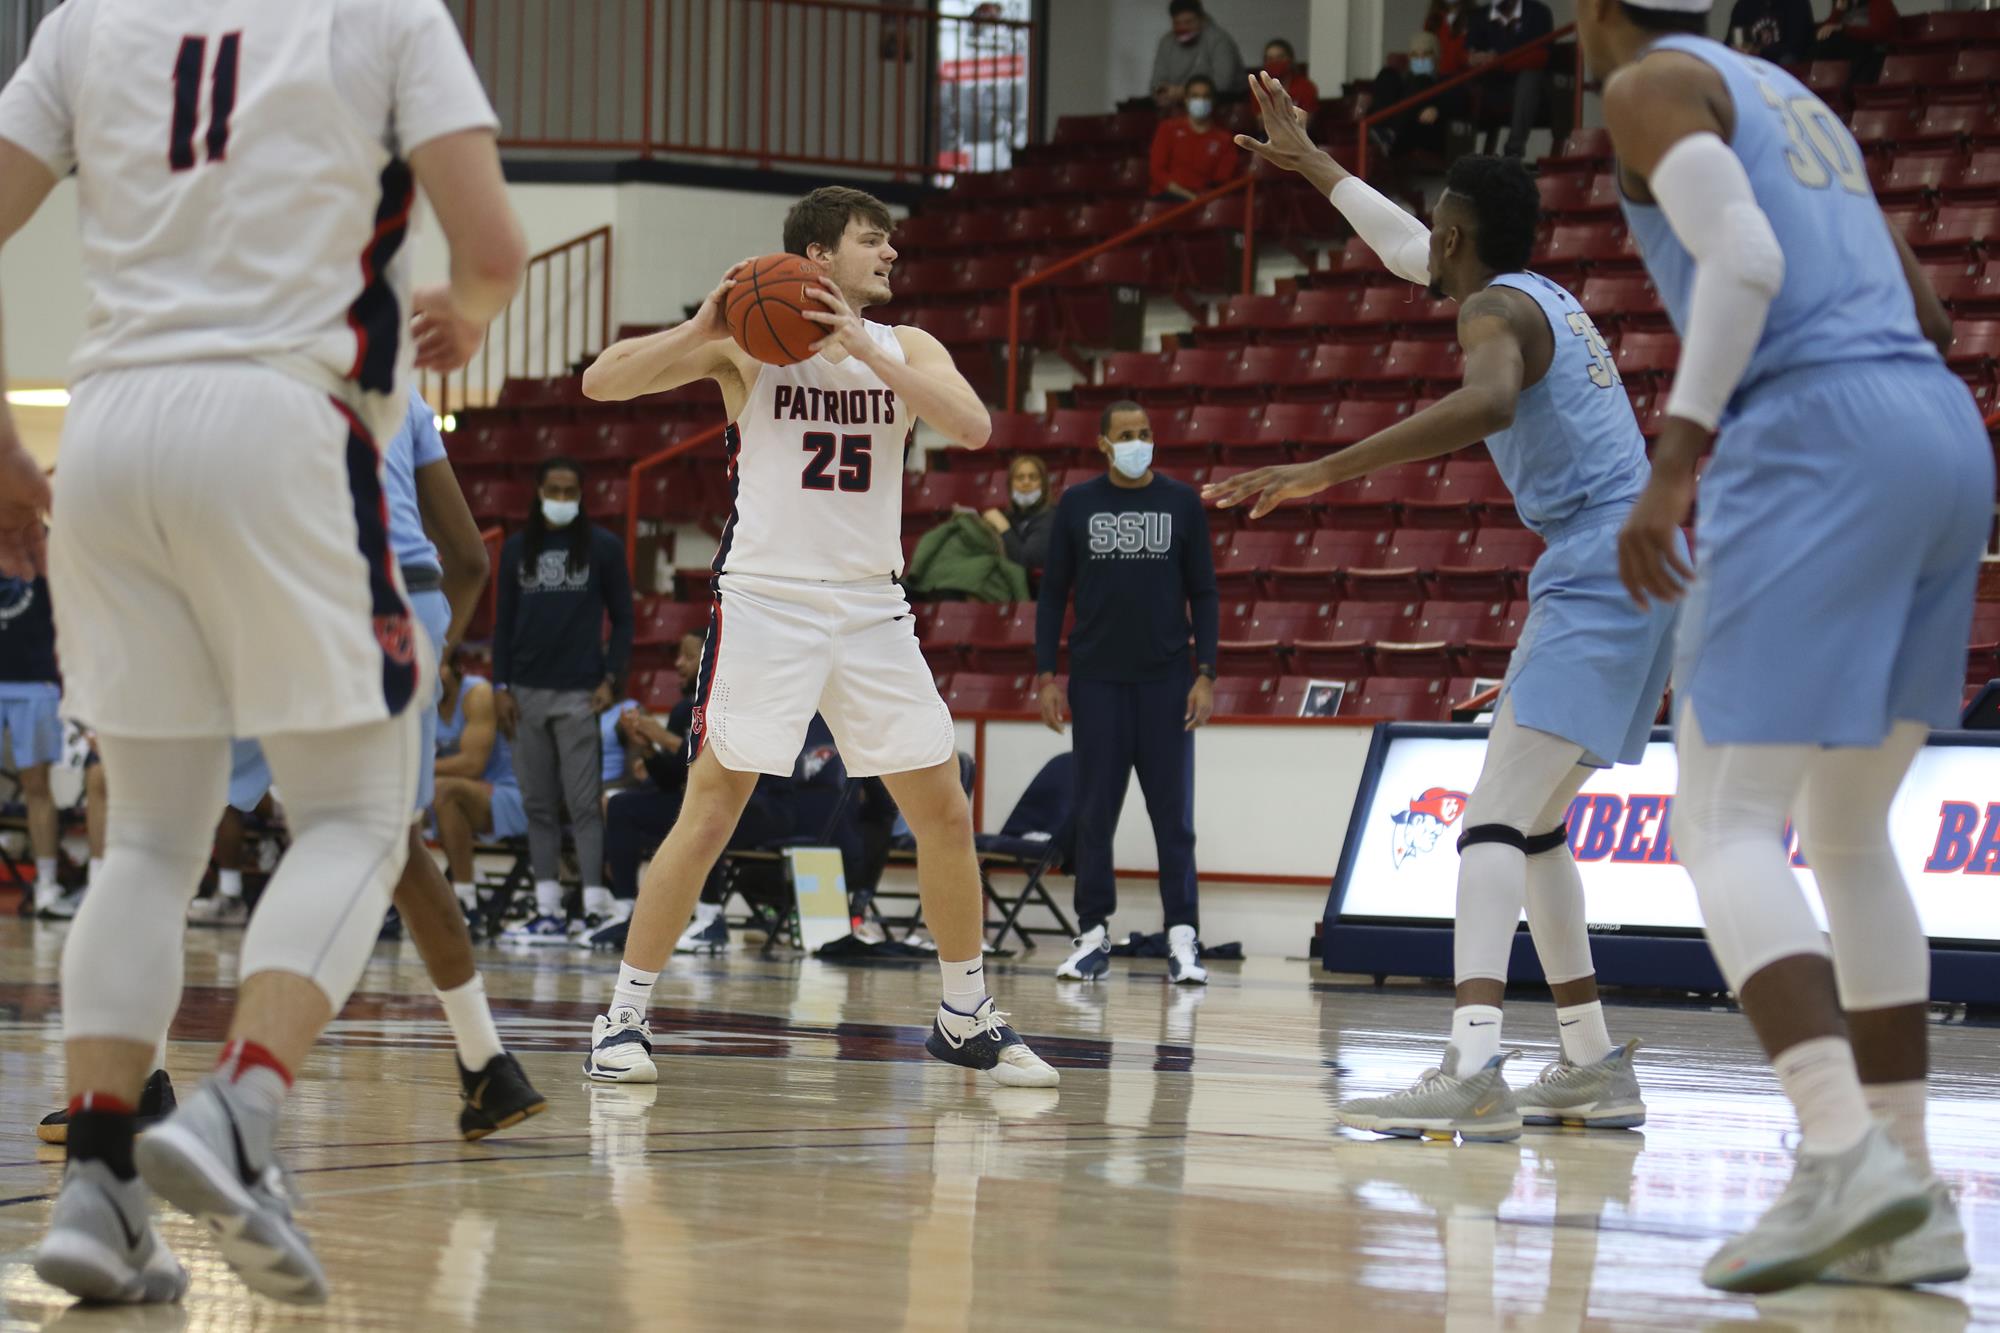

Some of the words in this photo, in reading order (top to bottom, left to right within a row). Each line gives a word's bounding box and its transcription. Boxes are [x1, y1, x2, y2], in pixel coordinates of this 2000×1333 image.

[169, 31, 242, 172] 11
[1757, 79, 1870, 198] 30
[774, 384, 896, 425] PATRIOTS
[801, 431, 872, 493] 25
[1089, 511, 1173, 553] SSU
